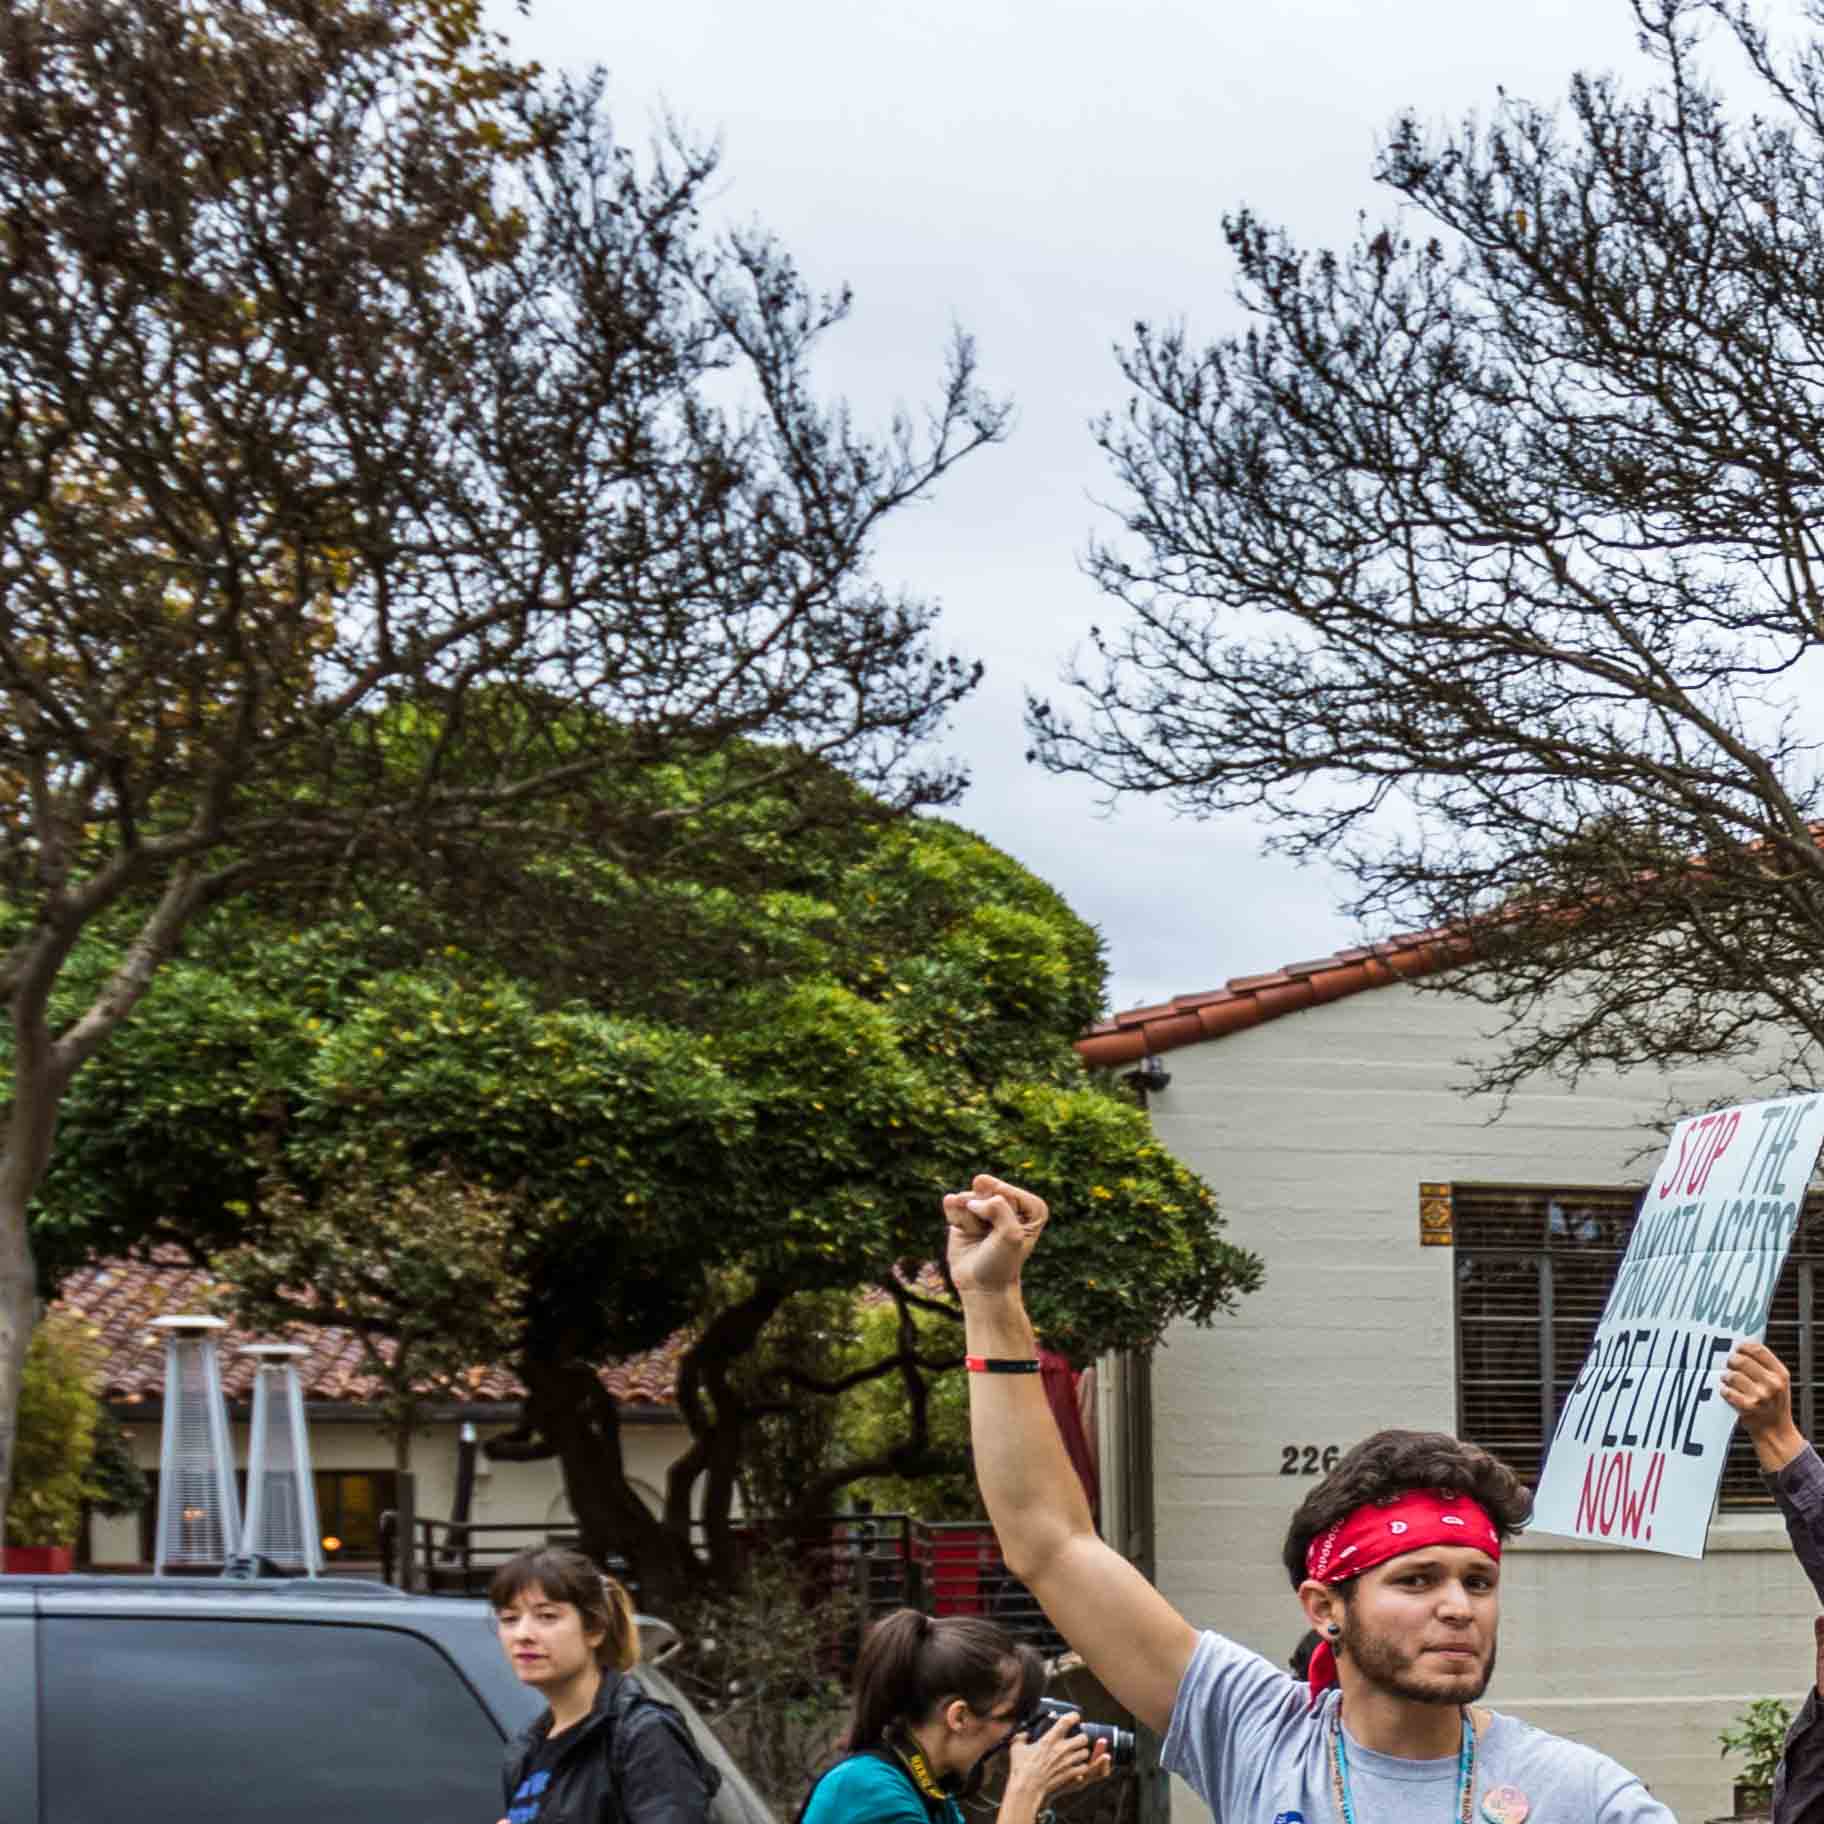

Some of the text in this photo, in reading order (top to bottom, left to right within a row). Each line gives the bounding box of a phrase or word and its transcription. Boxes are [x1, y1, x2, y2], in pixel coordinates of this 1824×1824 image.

[1659, 1101, 1817, 1199] STOP THE
[1682, 1200, 1797, 1336] ACCESS
[1556, 1328, 1733, 1456] PIPELINE
[1575, 1451, 1666, 1541] NOW!
